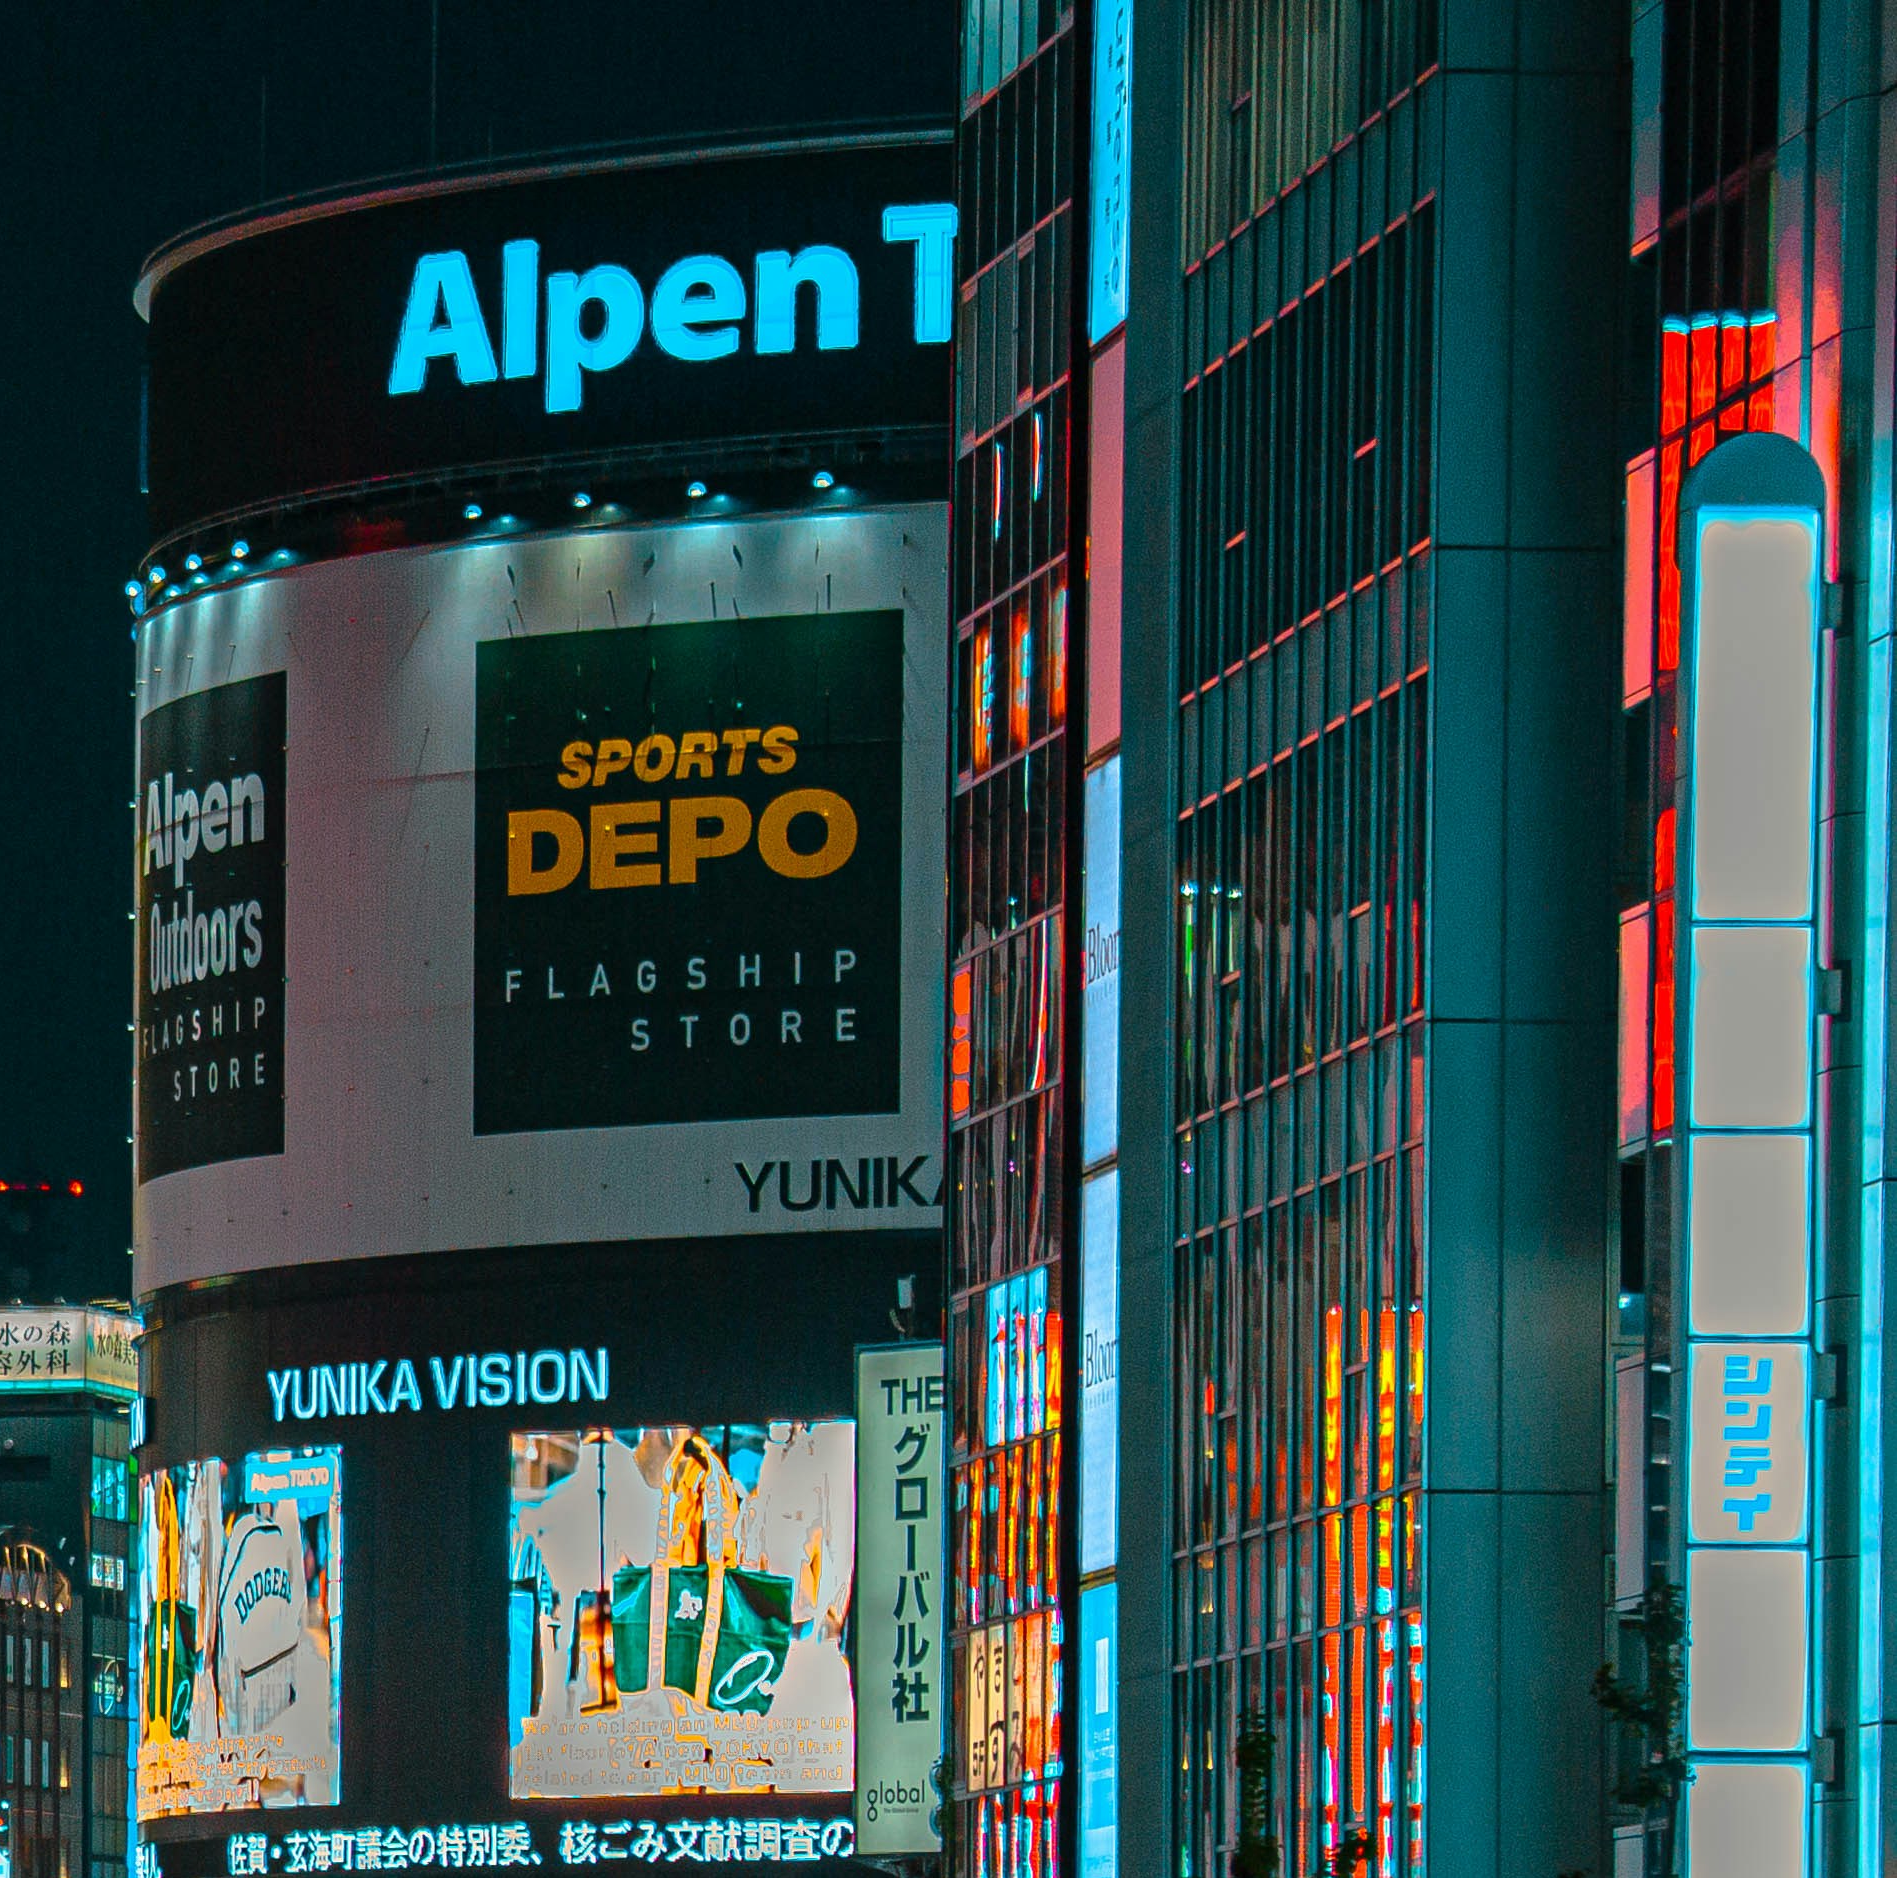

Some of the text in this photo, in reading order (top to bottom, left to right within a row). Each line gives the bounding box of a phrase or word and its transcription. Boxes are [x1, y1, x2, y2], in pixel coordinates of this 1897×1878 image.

[388, 238, 859, 414] Alpen
[558, 724, 800, 790] SPORTS
[143, 771, 265, 887] Alpen
[506, 788, 859, 896] DEPO
[150, 900, 264, 997] Outdoors
[506, 949, 857, 1004] FLAGSHIP
[143, 998, 266, 1057] FLAGSHIP
[631, 1010, 857, 1053] STORE
[173, 1050, 266, 1102] STORE
[268, 1349, 609, 1422] YUNIKA VISION
[881, 1376, 942, 1415] THE
[893, 1425, 930, 1725] グローバル社
[866, 1781, 927, 1823] global
